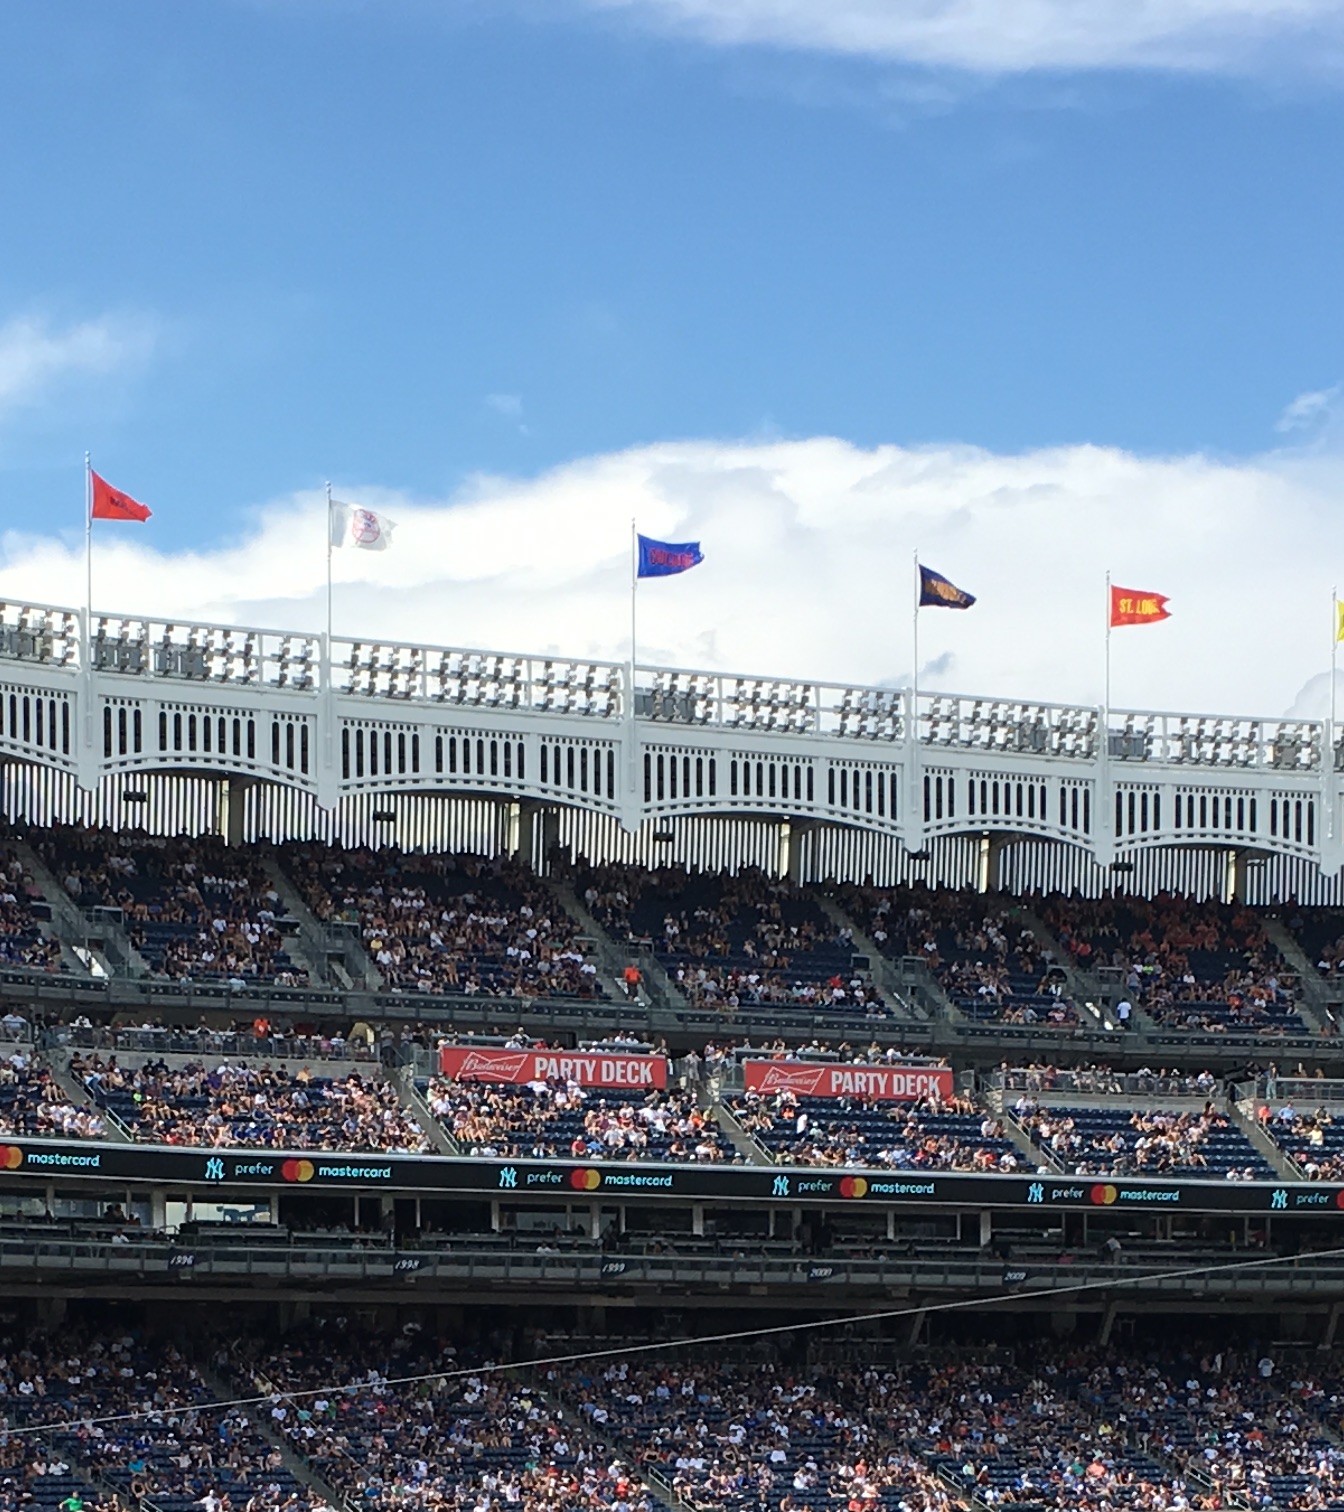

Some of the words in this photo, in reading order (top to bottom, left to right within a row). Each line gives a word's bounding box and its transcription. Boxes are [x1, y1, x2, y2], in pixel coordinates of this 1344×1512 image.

[465, 1058, 519, 1073] Budweiser
[535, 1057, 597, 1081] PARTY
[601, 1059, 654, 1084] DECK
[831, 1071, 887, 1094] PARTY
[893, 1074, 941, 1097] DECK
[27, 1153, 101, 1167] mastercard
[235, 1163, 273, 1176] prefer
[318, 1166, 392, 1179] mastercard
[527, 1172, 564, 1185] prefer
[604, 1174, 674, 1187] mastercard
[798, 1180, 833, 1193] prefer
[871, 1182, 935, 1194] mastercard
[1051, 1188, 1084, 1201] prefer
[1119, 1190, 1180, 1202] mastercard
[1296, 1193, 1330, 1206] prefer
